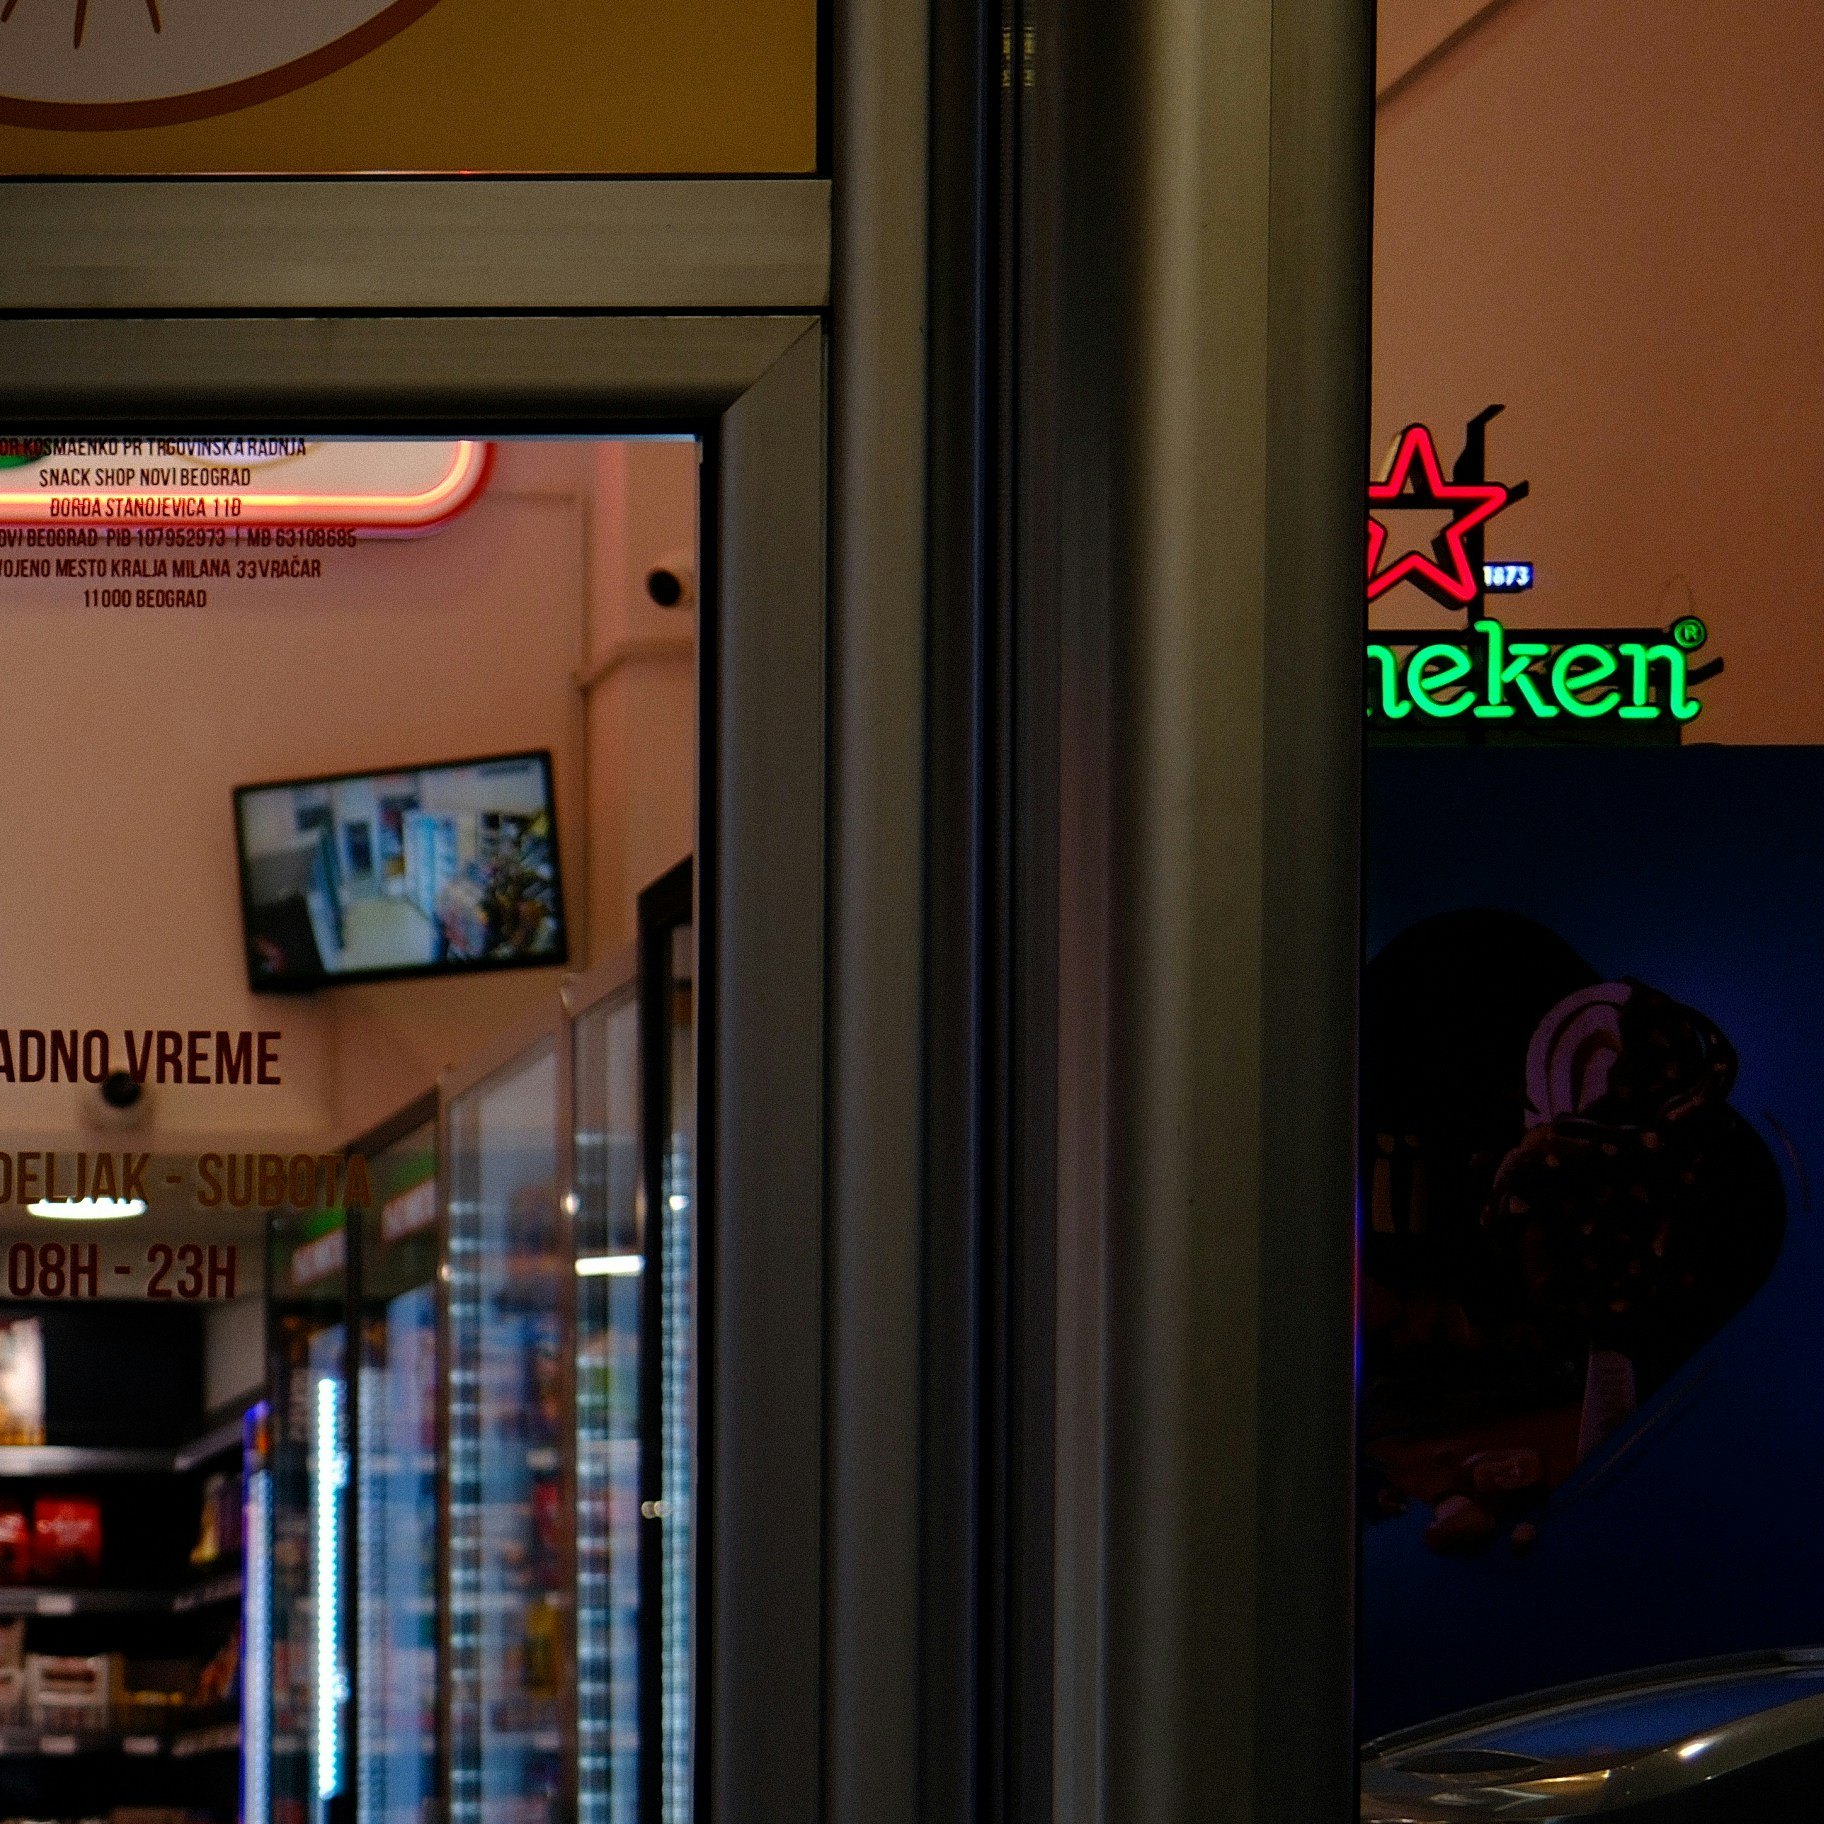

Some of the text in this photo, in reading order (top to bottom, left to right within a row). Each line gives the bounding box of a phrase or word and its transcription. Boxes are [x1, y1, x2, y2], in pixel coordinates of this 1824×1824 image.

[123, 437, 144, 457] PR
[147, 437, 243, 457] TRGOVINSKA
[247, 437, 307, 457] RADNJA
[39, 467, 251, 487] SNACK SHOP NOVI BEOGRAD
[26, 528, 98, 547] BEOGRAD
[106, 528, 132, 547] PIB
[247, 528, 271, 547] MB
[55, 559, 106, 577] MESTO
[110, 559, 168, 578] KRALJA
[172, 559, 231, 578] MILANA
[1483, 565, 1531, 588] 1873
[83, 589, 207, 608] 11000 BEOGRAD
[123, 1029, 282, 1086] VREME
[197, 1152, 374, 1209] SUBOTA
[6, 1242, 100, 1298] 08H
[146, 1243, 238, 1300] 23H
